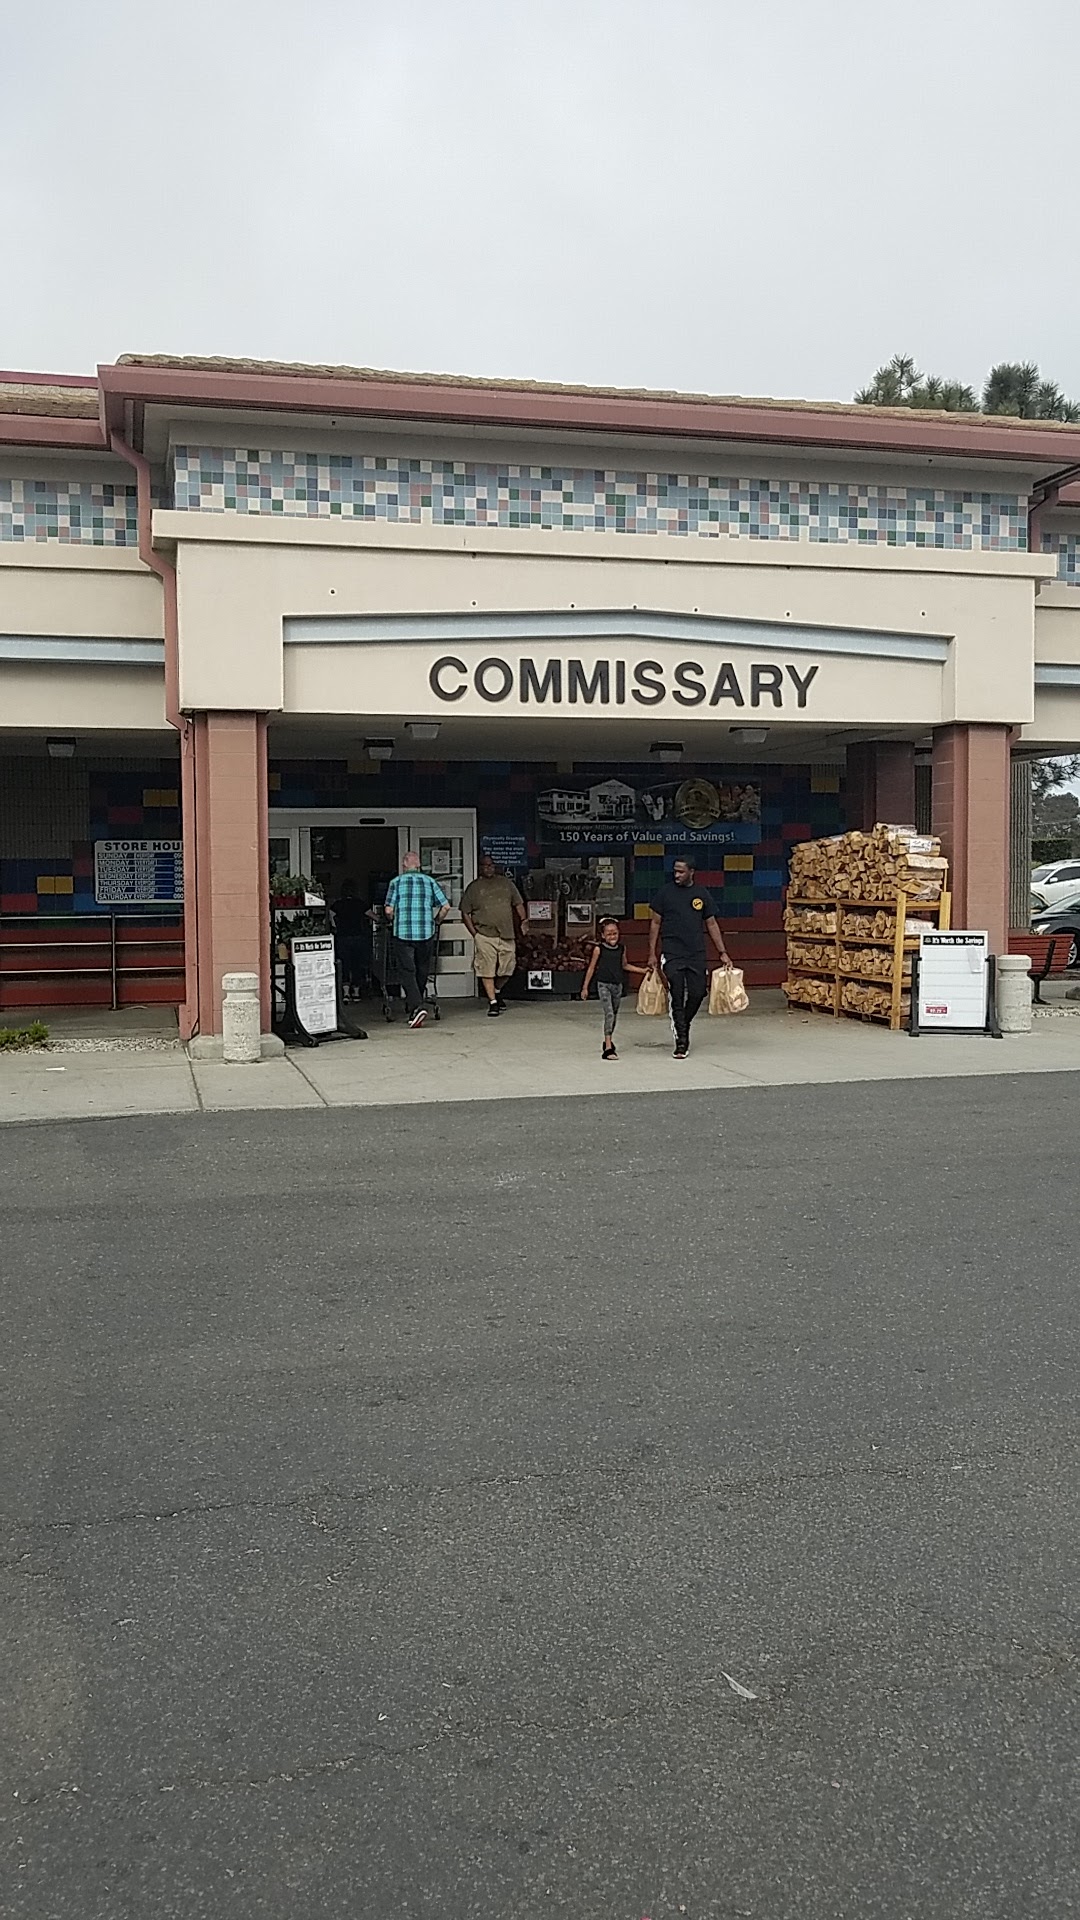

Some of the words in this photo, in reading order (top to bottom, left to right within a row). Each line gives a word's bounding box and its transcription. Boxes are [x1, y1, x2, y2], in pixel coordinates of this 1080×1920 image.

[428, 655, 820, 709] COMMISSARY
[560, 832, 580, 842] 150
[583, 832, 613, 842] Years
[616, 832, 629, 842] of
[631, 832, 662, 842] Value
[665, 832, 687, 842] and
[689, 832, 735, 844] Savings!
[104, 842, 148, 851] STORE
[152, 842, 184, 851] HOU
[965, 937, 983, 945] Savings
